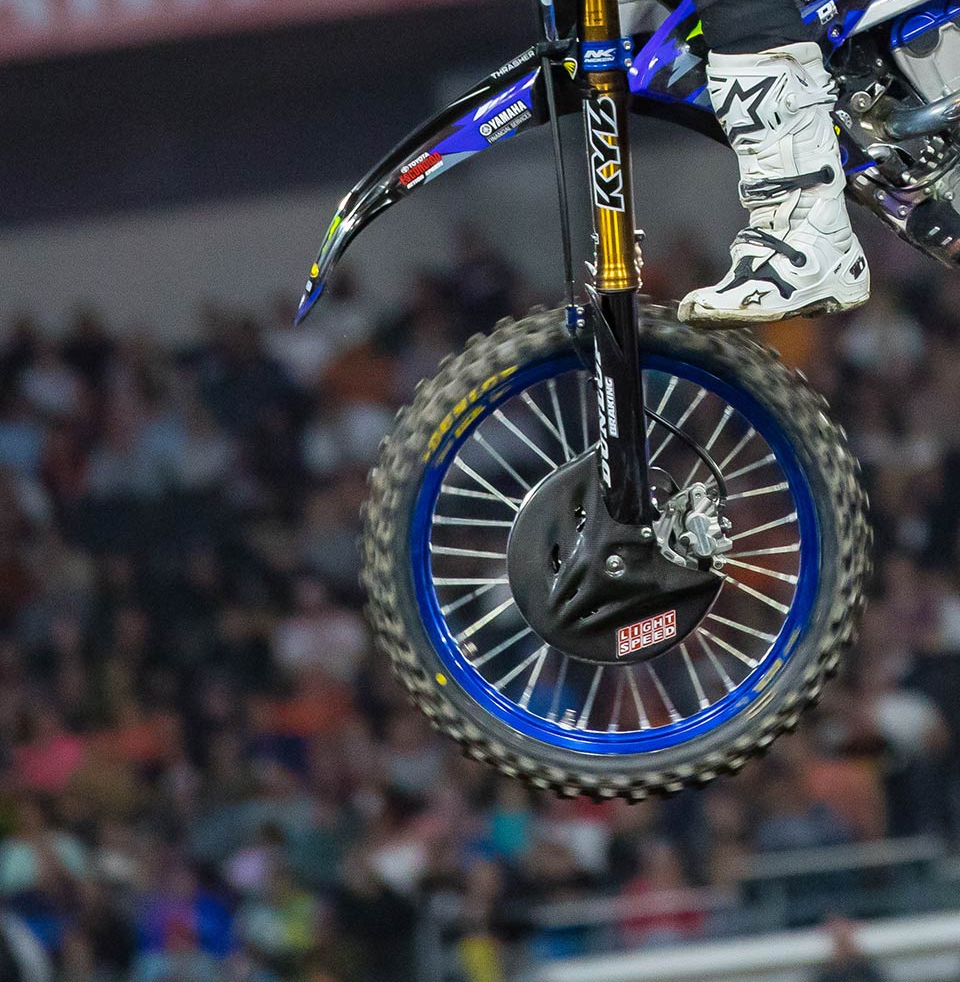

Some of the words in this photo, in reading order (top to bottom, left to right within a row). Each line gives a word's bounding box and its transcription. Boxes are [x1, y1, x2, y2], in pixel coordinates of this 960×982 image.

[489, 49, 536, 79] THRASHER
[487, 125, 512, 144] FINANCIAL
[510, 112, 533, 131] SERVICES
[488, 100, 528, 129] YAMAHA
[399, 151, 443, 186] ESCONDIDO
[407, 152, 431, 170] TOYOTA
[583, 96, 626, 213] KYB
[607, 377, 620, 439] BRAKING
[618, 623, 678, 658] SPEED
[619, 610, 677, 642] LIGHT
